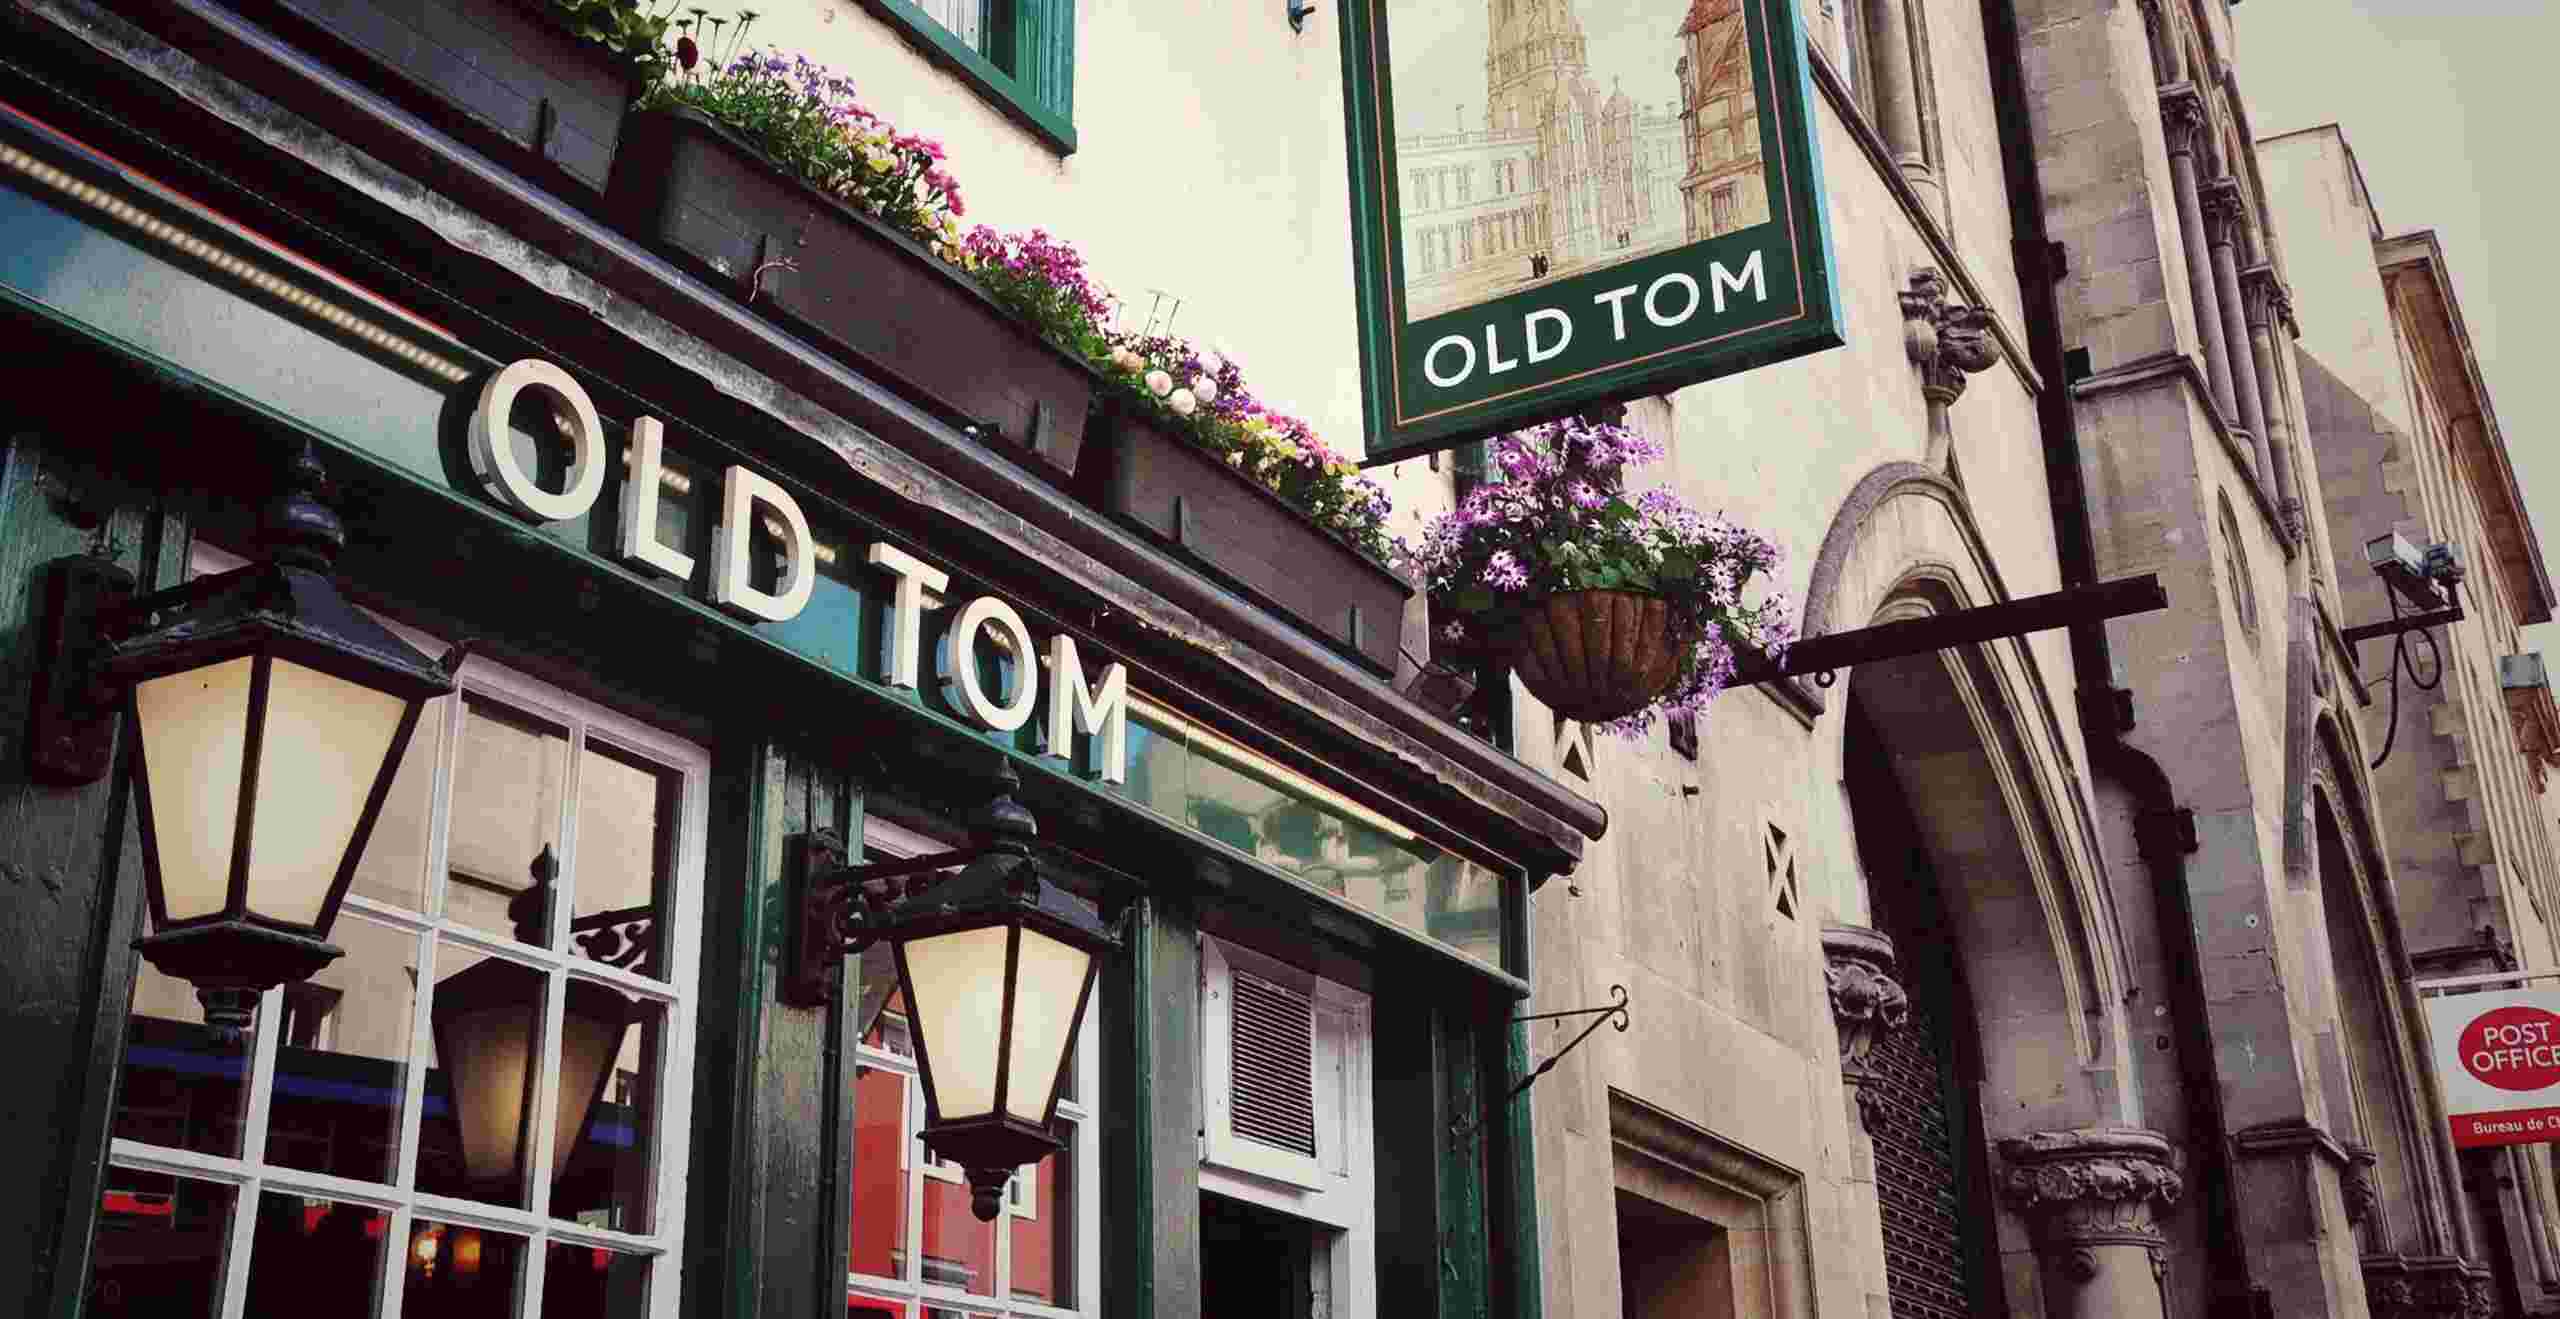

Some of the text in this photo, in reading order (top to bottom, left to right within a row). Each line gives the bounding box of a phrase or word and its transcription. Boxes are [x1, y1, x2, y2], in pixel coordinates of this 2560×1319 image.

[1423, 250, 1768, 388] OLD TOM
[471, 357, 1128, 785] OLD TOM
[2483, 1022, 2551, 1047] POST
[2472, 1044, 2560, 1072] OFFICE
[2473, 1121, 2523, 1134] Bureau
[2527, 1118, 2544, 1131] de
